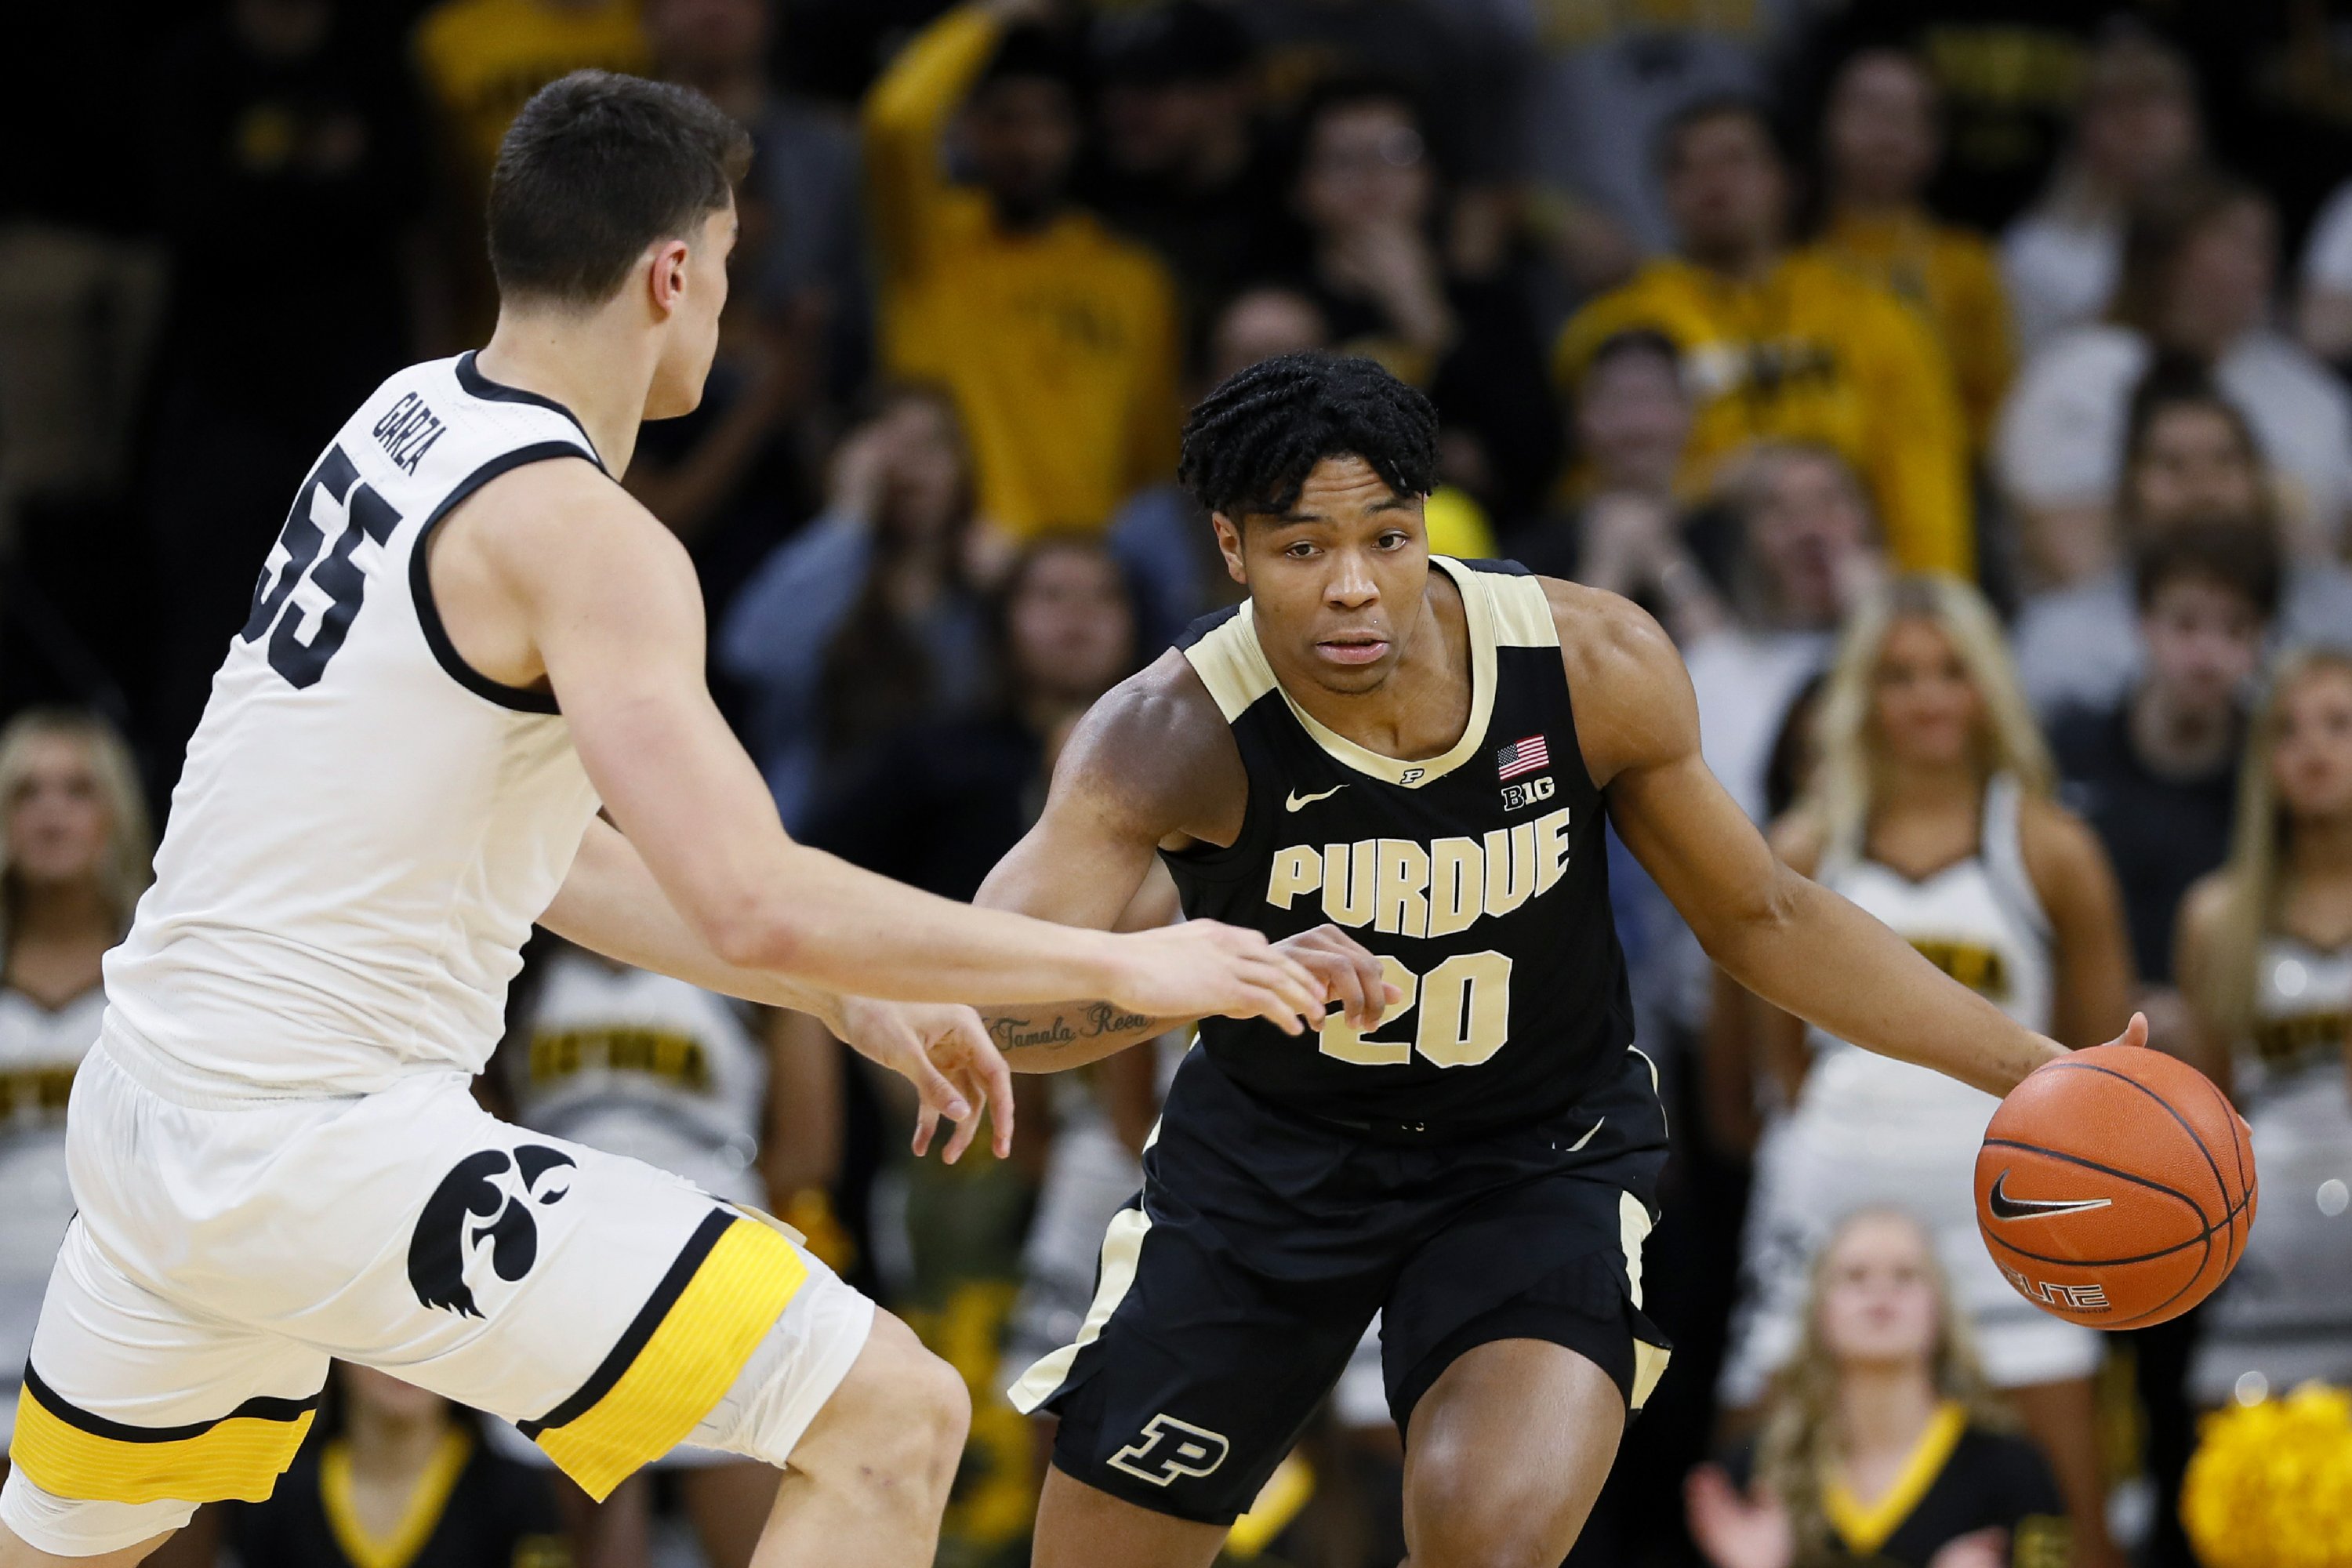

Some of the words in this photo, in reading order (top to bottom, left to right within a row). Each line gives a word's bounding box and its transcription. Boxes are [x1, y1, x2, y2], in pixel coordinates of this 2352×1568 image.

[372, 391, 447, 477] GARZA
[241, 442, 404, 690] 55
[1399, 768, 1425, 785] P
[1266, 807, 1570, 939] PURDUE
[990, 1015, 1076, 1051] Tamala
[1319, 949, 1513, 1069] 20
[1106, 1413, 1230, 1487] P
